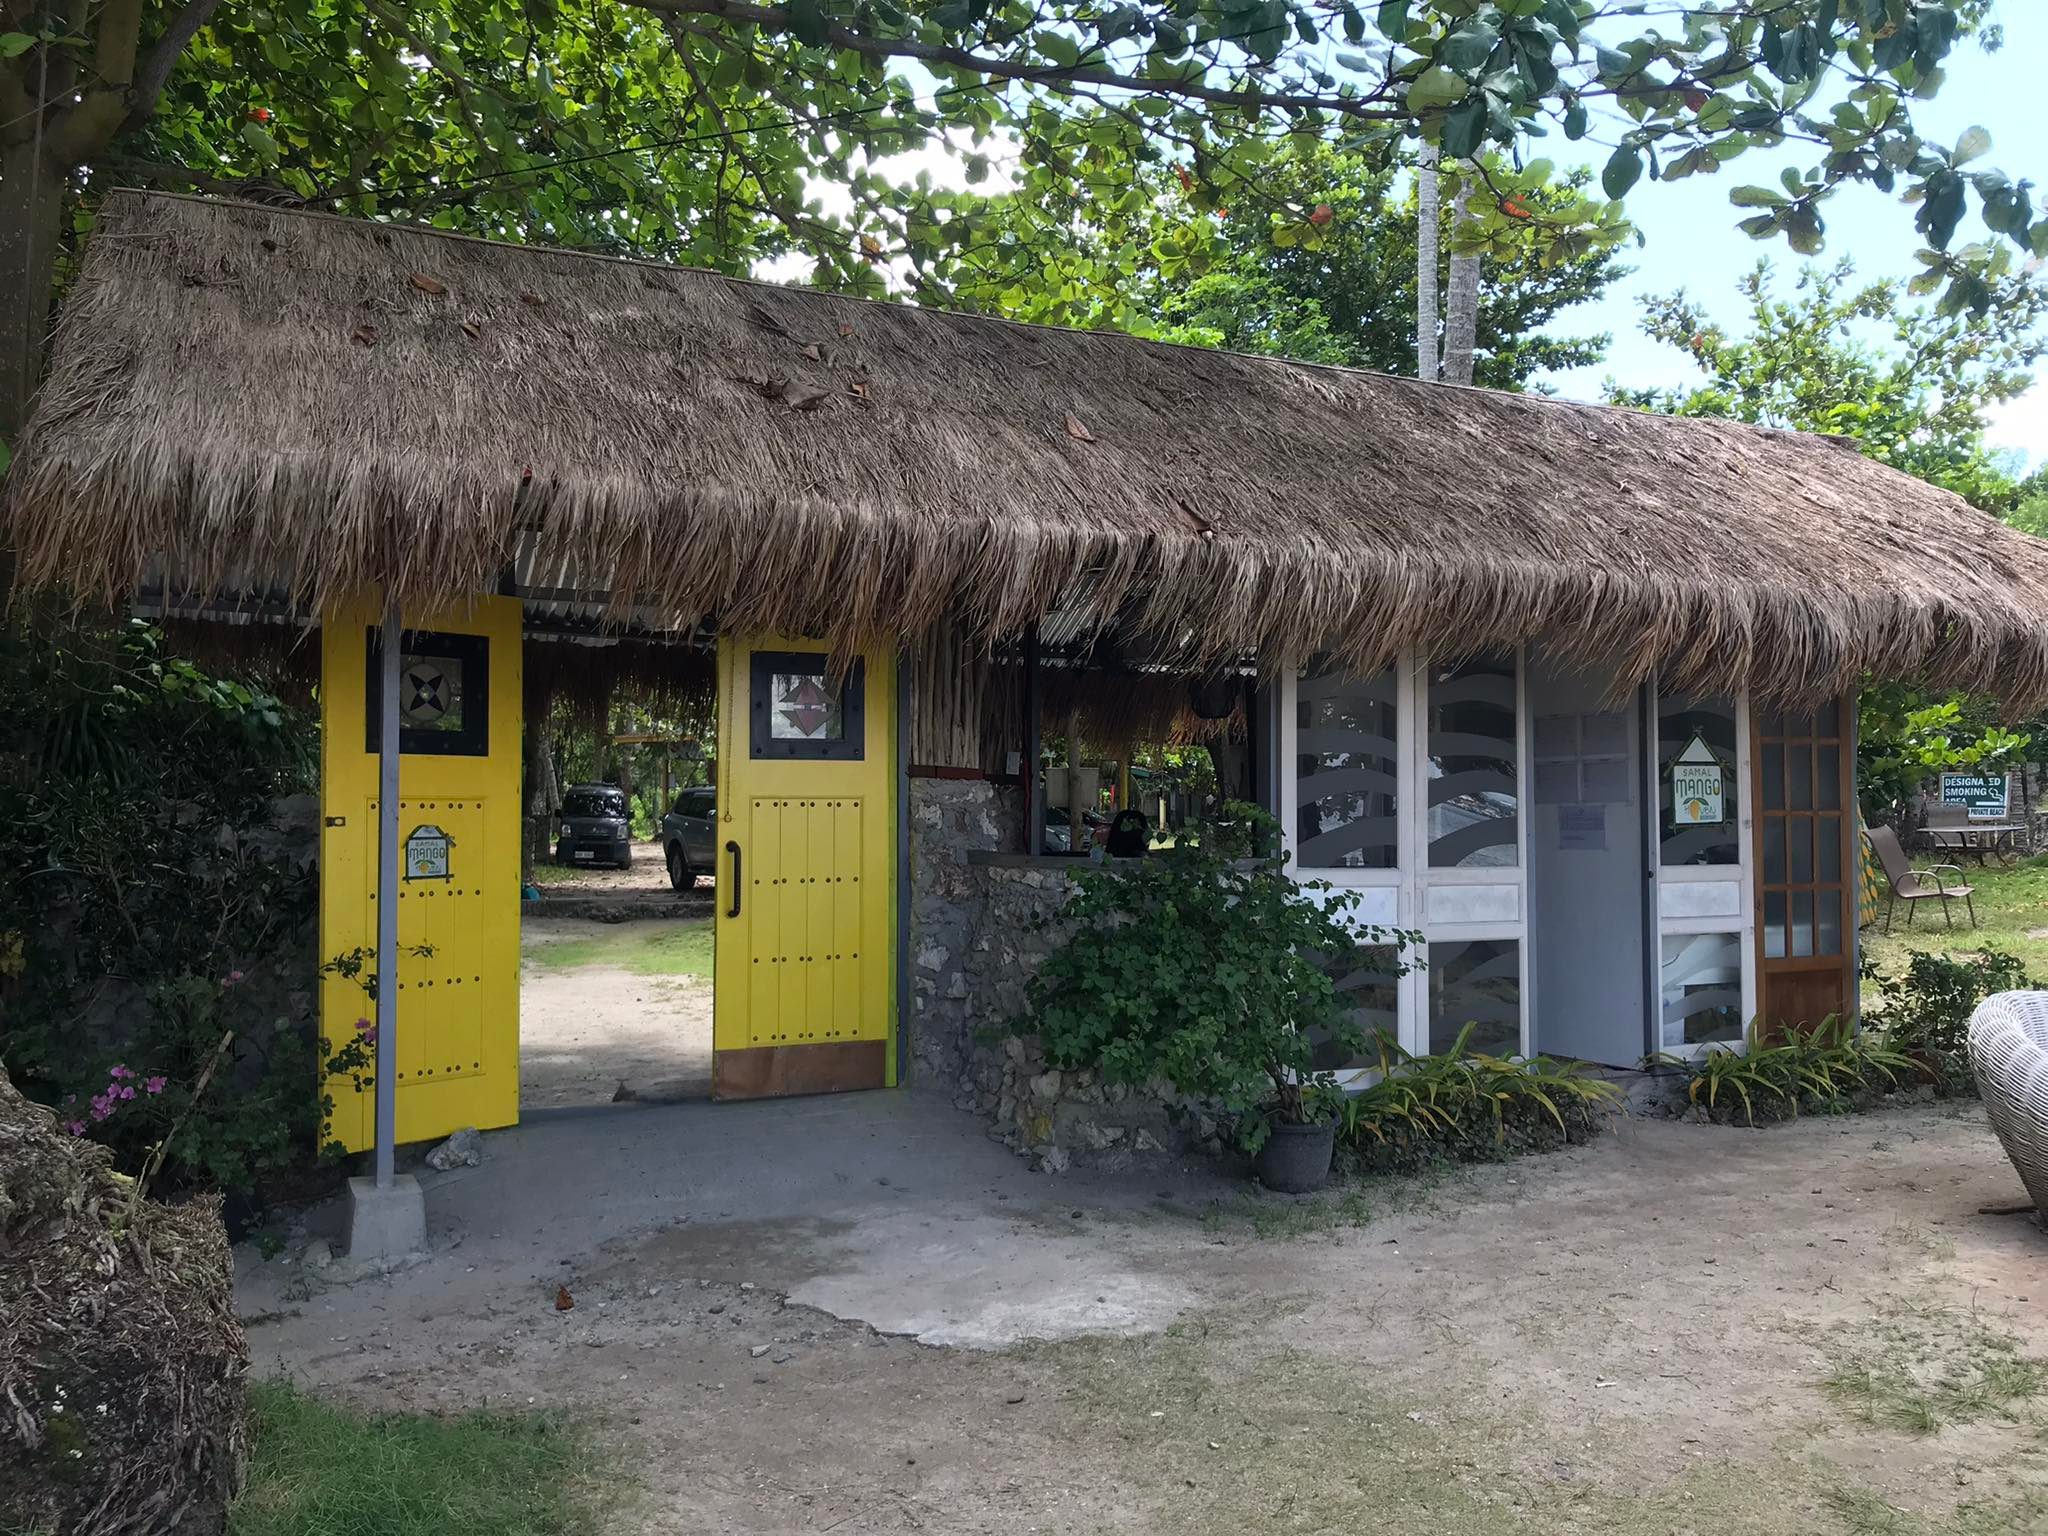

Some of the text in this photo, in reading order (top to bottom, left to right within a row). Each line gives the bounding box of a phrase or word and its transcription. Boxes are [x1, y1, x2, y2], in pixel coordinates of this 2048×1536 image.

[1682, 768, 1712, 777] SAMAL
[1945, 778, 2001, 786] DESIGNAED
[1676, 778, 1720, 798] MANGO
[1945, 788, 1987, 796] SMOKING
[410, 848, 446, 860] MANGO
